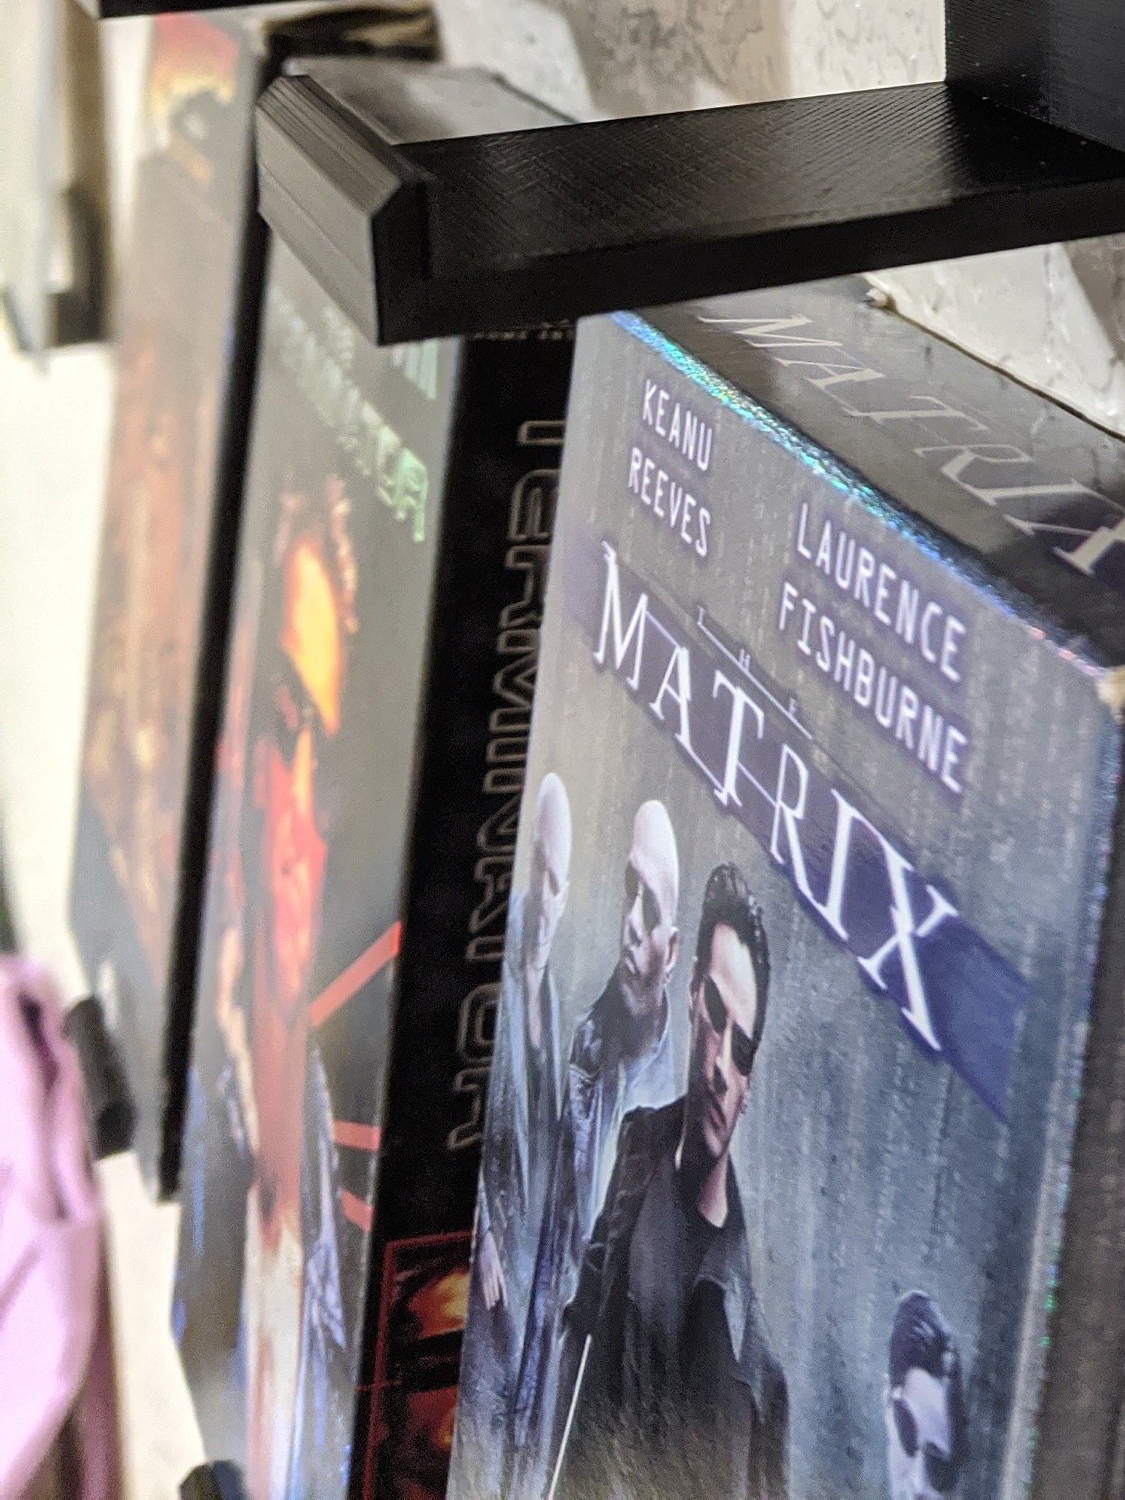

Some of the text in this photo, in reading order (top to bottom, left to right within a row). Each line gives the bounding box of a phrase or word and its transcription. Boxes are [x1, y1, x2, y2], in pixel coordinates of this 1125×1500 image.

[627, 445, 712, 559] REEVES
[641, 376, 714, 473] KEANU
[796, 501, 967, 684] LAURENCE
[778, 581, 969, 796] FISHBURNE
[593, 540, 960, 1052] MATRIX
